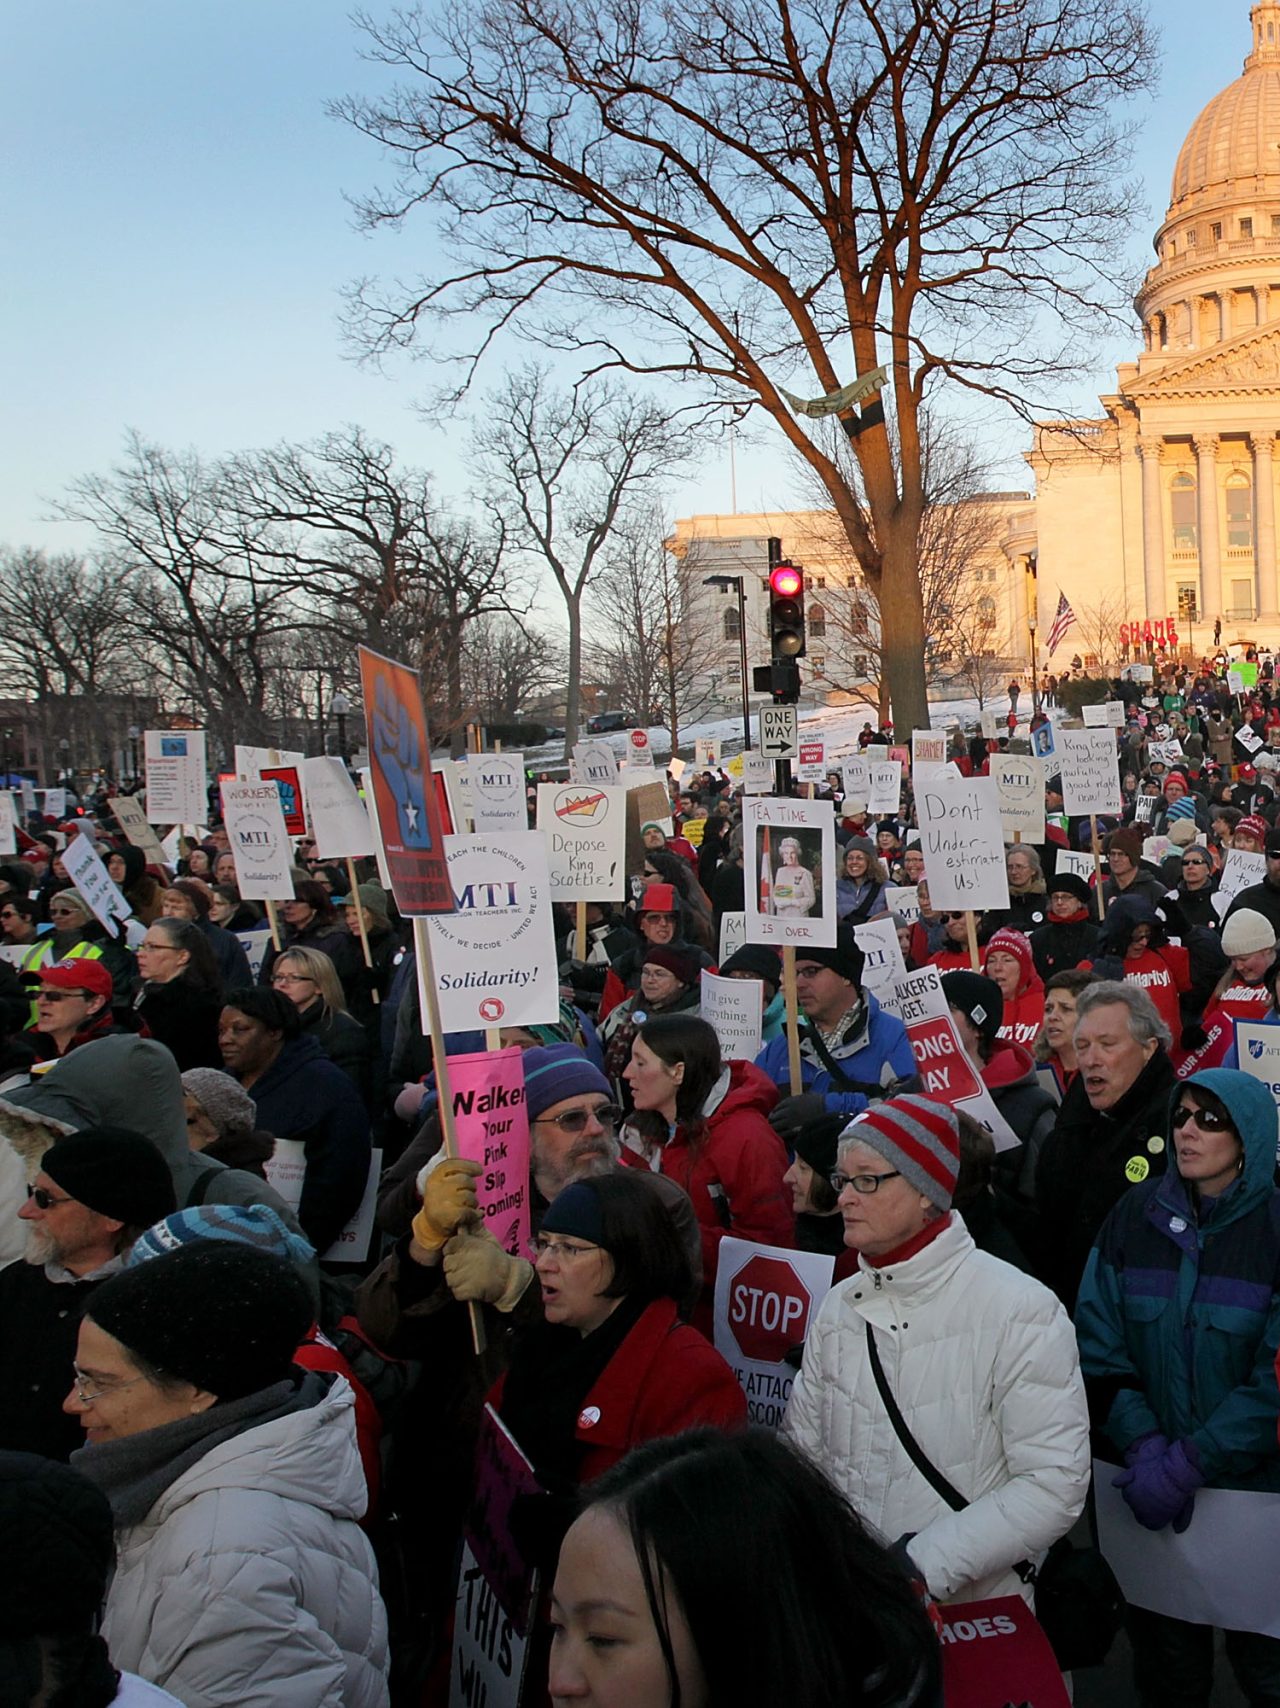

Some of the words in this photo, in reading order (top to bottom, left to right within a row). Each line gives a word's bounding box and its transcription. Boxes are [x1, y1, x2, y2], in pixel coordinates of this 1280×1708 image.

[1120, 617, 1176, 644] SHAME
[764, 712, 792, 724] ONE
[631, 735, 647, 743] STOP
[764, 726, 793, 738] WAY
[916, 738, 945, 760] SHAME!
[482, 774, 512, 785] MTI
[588, 765, 609, 778] MTI
[1002, 774, 1030, 786] MTI
[229, 786, 279, 800] WORKERS
[480, 810, 520, 819] Solidarity!
[748, 801, 771, 821] TEA
[777, 806, 808, 824] TIME
[925, 793, 983, 822] Don't
[122, 813, 143, 825] MTI
[239, 831, 270, 844] MTI
[552, 833, 608, 860] Depose
[928, 830, 988, 855] Under-
[447, 847, 468, 864] EACH
[492, 847, 526, 872] CHILDREN
[569, 856, 594, 875] King
[946, 851, 1001, 869] estimate
[1236, 872, 1250, 887] to
[454, 881, 520, 909] MTI
[475, 909, 508, 917] TEACHERS
[530, 903, 537, 915] WE
[899, 907, 920, 919] MT
[431, 916, 454, 940] CTIVELY
[457, 938, 469, 948] WE
[473, 940, 502, 950] DECIDE
[511, 917, 532, 940] UNITED
[762, 923, 774, 934] IS
[786, 926, 813, 938] OVER
[865, 949, 886, 967] TI
[439, 966, 539, 991] Solidarity!
[894, 973, 939, 1000] ALKER'S
[718, 994, 741, 1006] give
[900, 999, 928, 1020] GET:
[716, 1024, 756, 1037] sconsin
[994, 1022, 1039, 1044] arity!
[916, 1032, 955, 1061] ONG
[1177, 1055, 1199, 1077] OUR
[923, 1067, 951, 1094] AY
[453, 1085, 526, 1117] Walker
[481, 1117, 514, 1139] Your
[484, 1142, 508, 1166] Pink
[485, 1171, 506, 1192] Slip
[478, 1186, 525, 1221] coming!
[731, 1283, 804, 1334] STOP
[747, 1373, 793, 1401] ATTAC
[463, 1566, 513, 1679] THIS
[939, 1614, 1018, 1646] HOES
